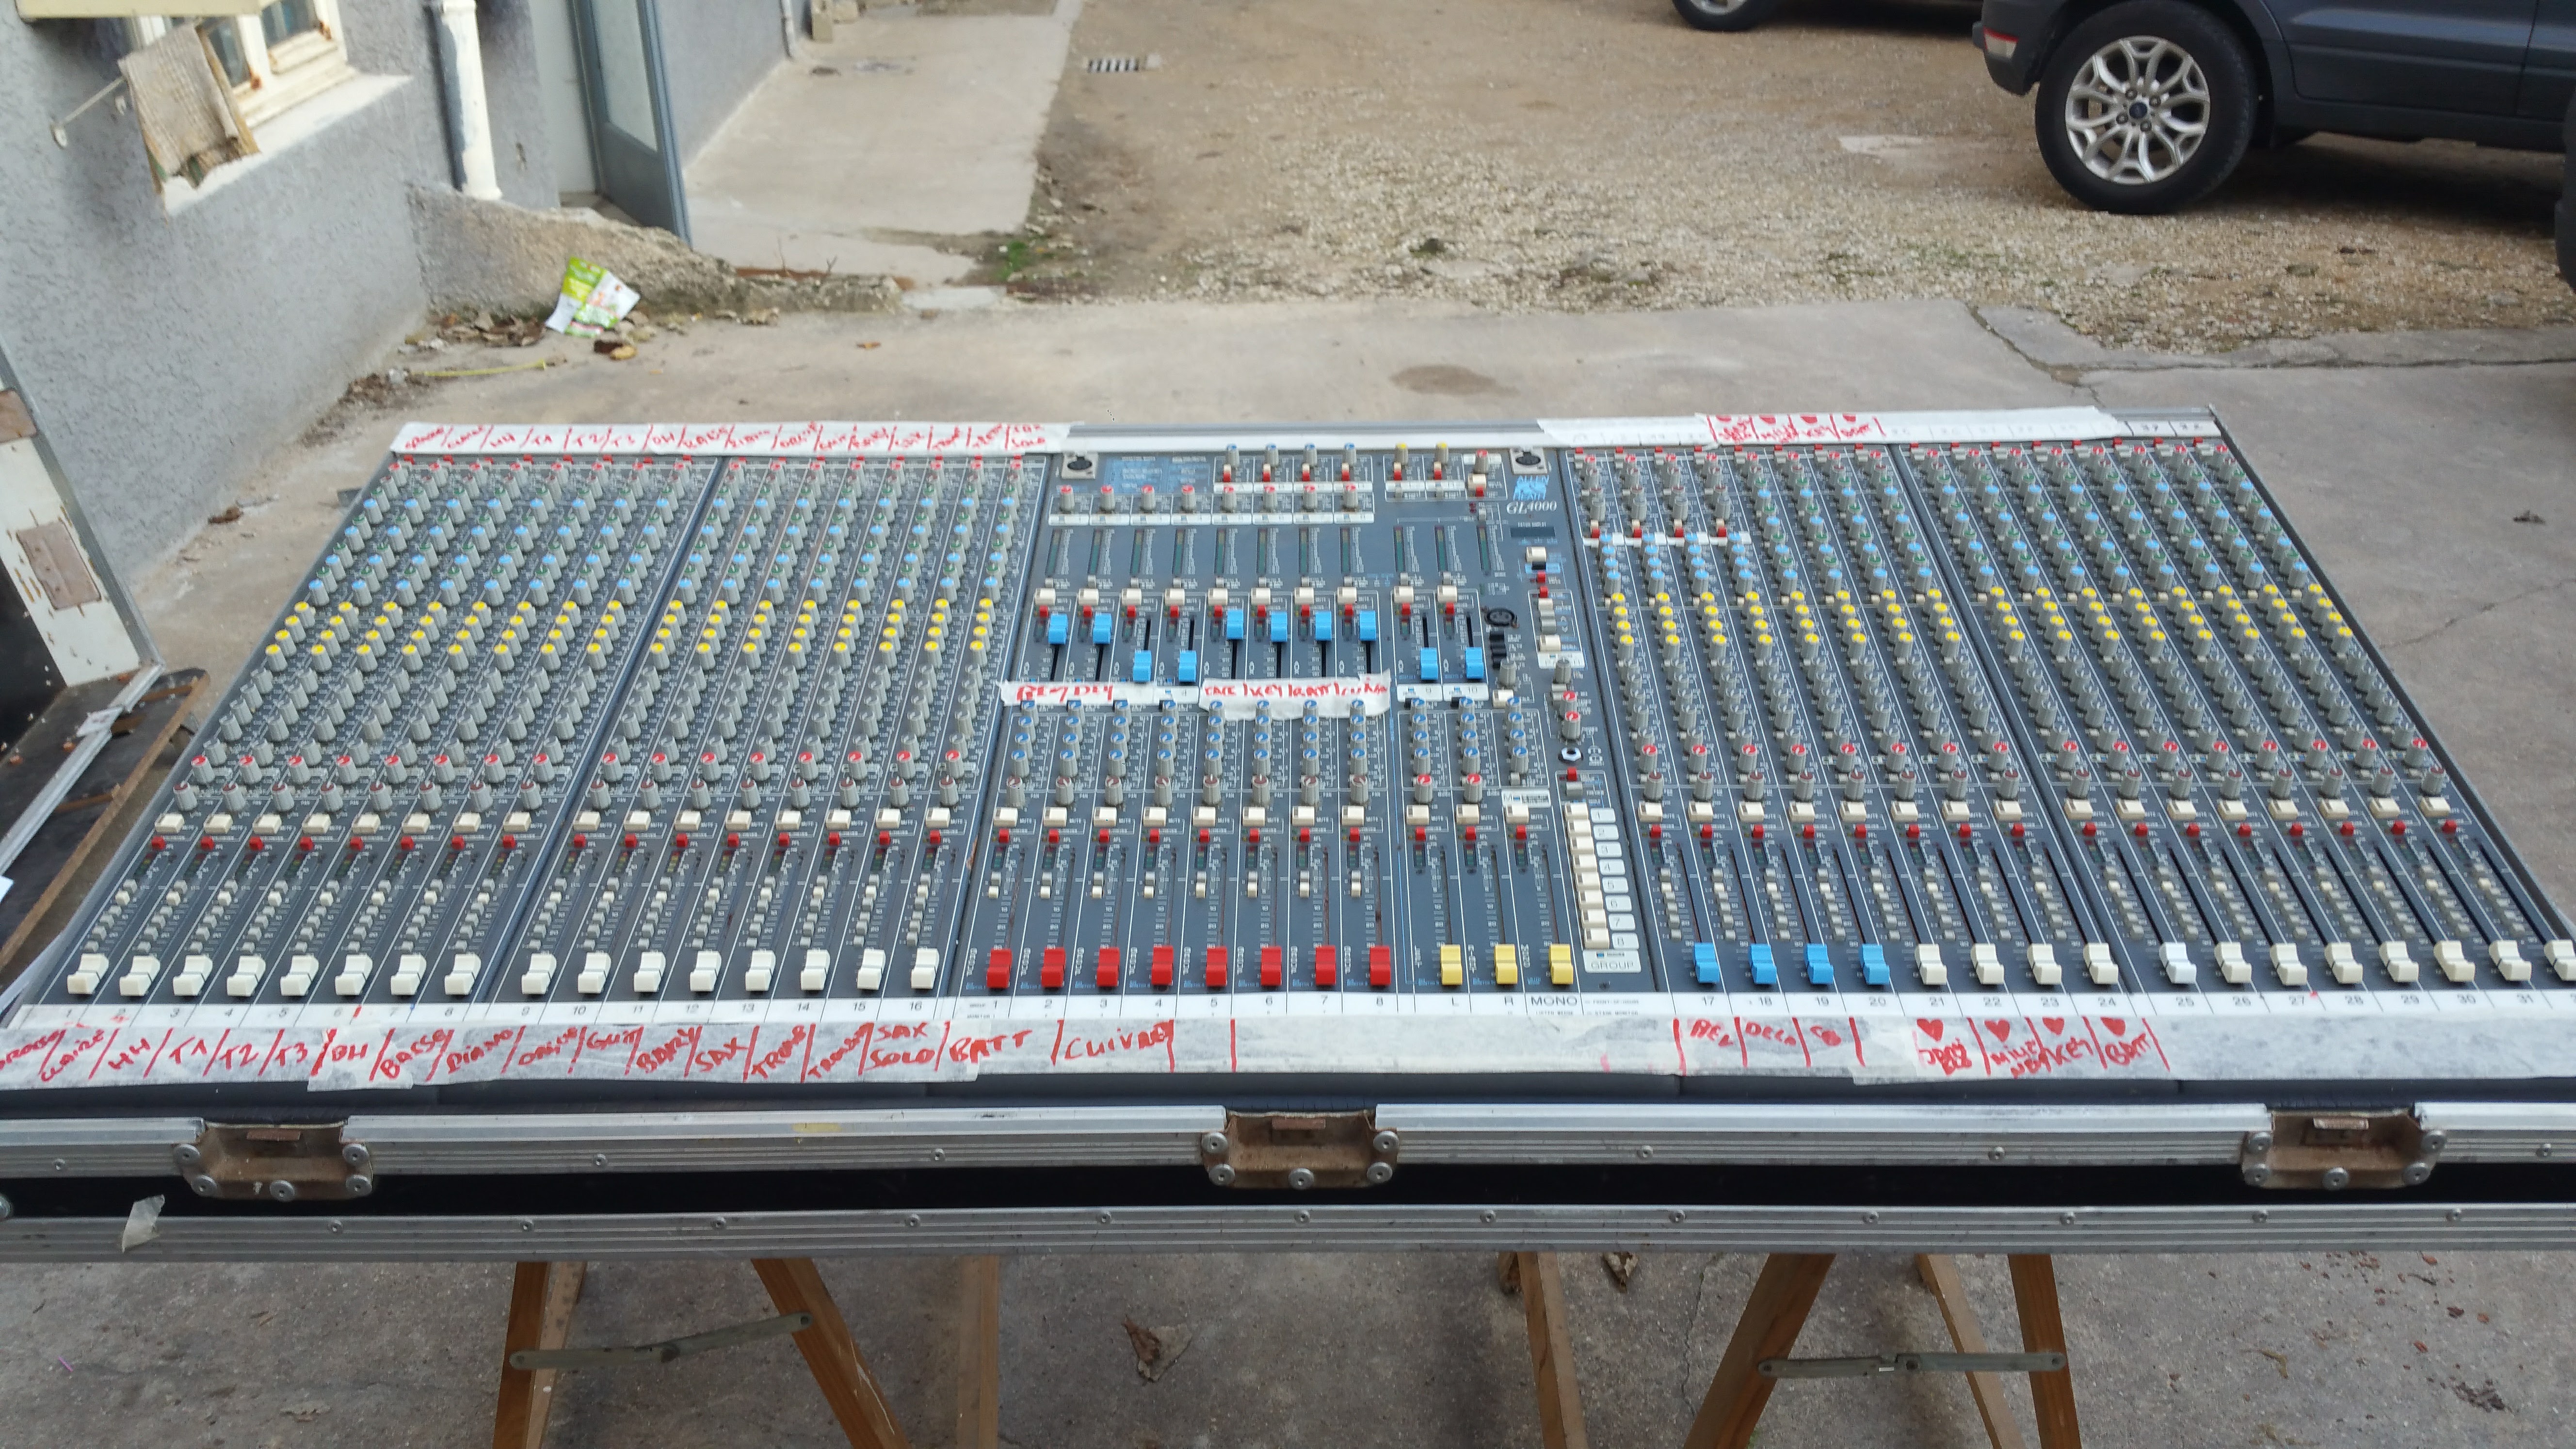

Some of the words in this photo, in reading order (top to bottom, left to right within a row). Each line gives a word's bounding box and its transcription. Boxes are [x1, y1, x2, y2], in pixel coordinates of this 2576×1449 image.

[1507, 501, 1557, 514] GL4000
[1591, 961, 1633, 970] GROUP
[1044, 998, 1053, 1009] 2
[1100, 998, 1108, 1008] 3
[1155, 998, 1162, 1008] 4
[1210, 997, 1218, 1008] 5
[1265, 996, 1273, 1006] 6
[1321, 995, 1328, 1005] 7
[1530, 996, 1578, 1006] MONO
[1702, 996, 1714, 1006] 17
[1759, 996, 1772, 1006] 18
[1816, 996, 1829, 1006] 19
[1868, 996, 1886, 1007] 20
[1929, 996, 1945, 1007] 21
[1983, 997, 2002, 1007] 22
[2041, 997, 2060, 1007] 23
[2098, 997, 2116, 1007] 24
[2175, 996, 2195, 1007] 25
[2232, 996, 2252, 1006] 26
[521, 1005, 531, 1016] 9
[573, 1005, 587, 1015] 10
[633, 1005, 644, 1014] 11
[686, 1003, 699, 1014] 12
[742, 1003, 755, 1013] 13
[798, 1002, 810, 1012] 14
[854, 1001, 866, 1012] 15
[910, 1001, 922, 1011] 16
[170, 1007, 180, 1018] 3
[224, 1008, 234, 1017] 4
[278, 1007, 290, 1018] 5
[444, 1007, 454, 1017] 8
[219, 1043, 258, 1070] T2
[274, 1042, 308, 1068] T3
